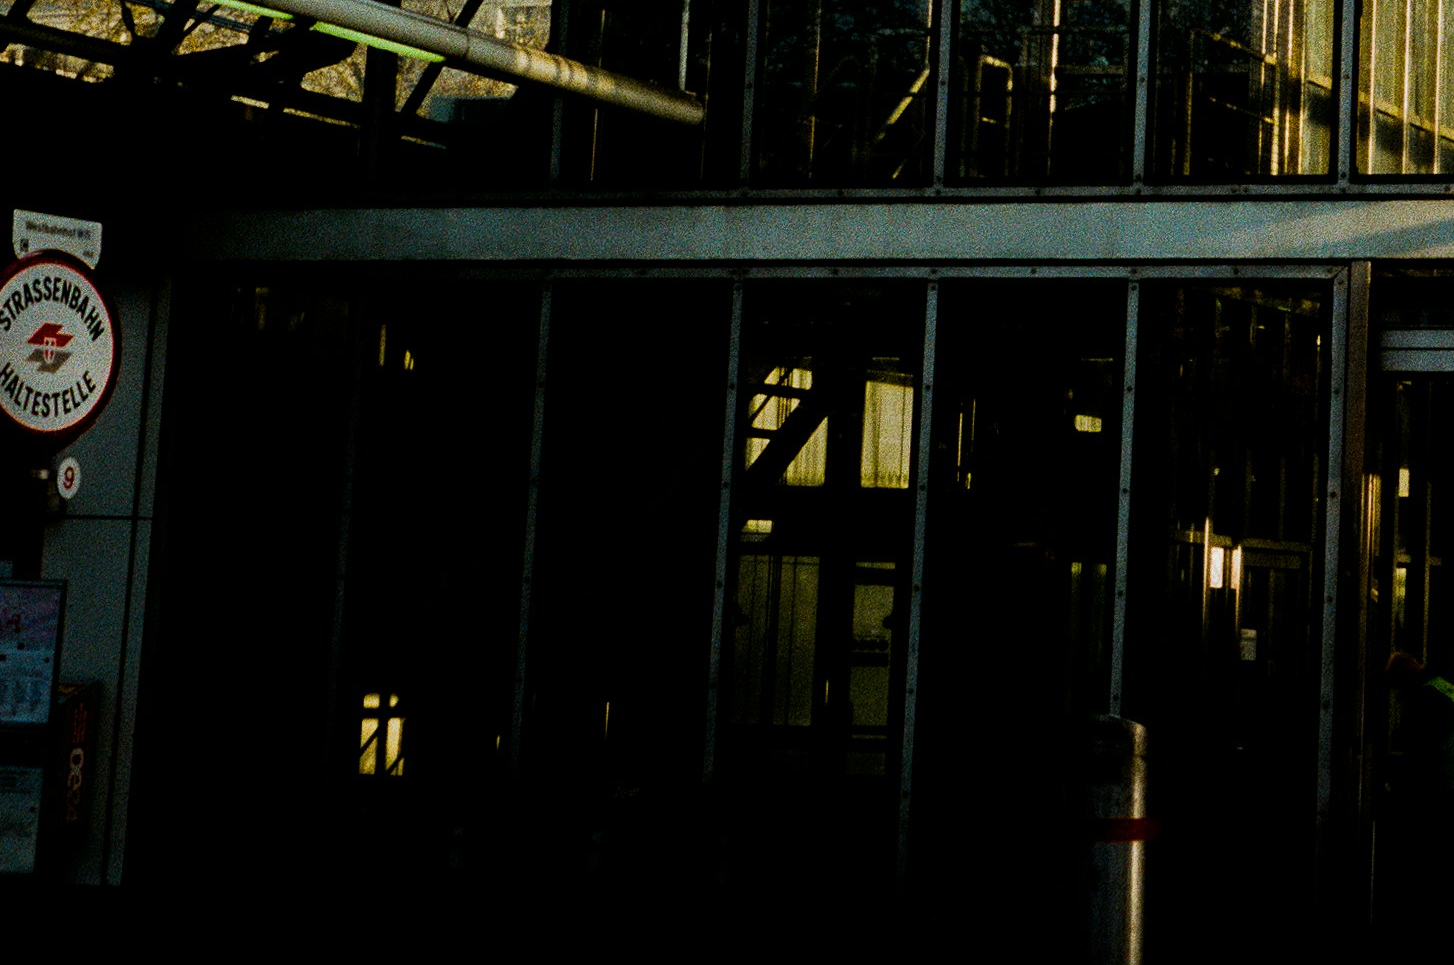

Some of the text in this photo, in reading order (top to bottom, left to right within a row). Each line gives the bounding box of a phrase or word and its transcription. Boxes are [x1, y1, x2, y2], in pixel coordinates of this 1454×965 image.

[0, 277, 105, 342] STRASSENBAHN
[0, 362, 96, 417] HALTESTELLE
[63, 465, 75, 490] 9
